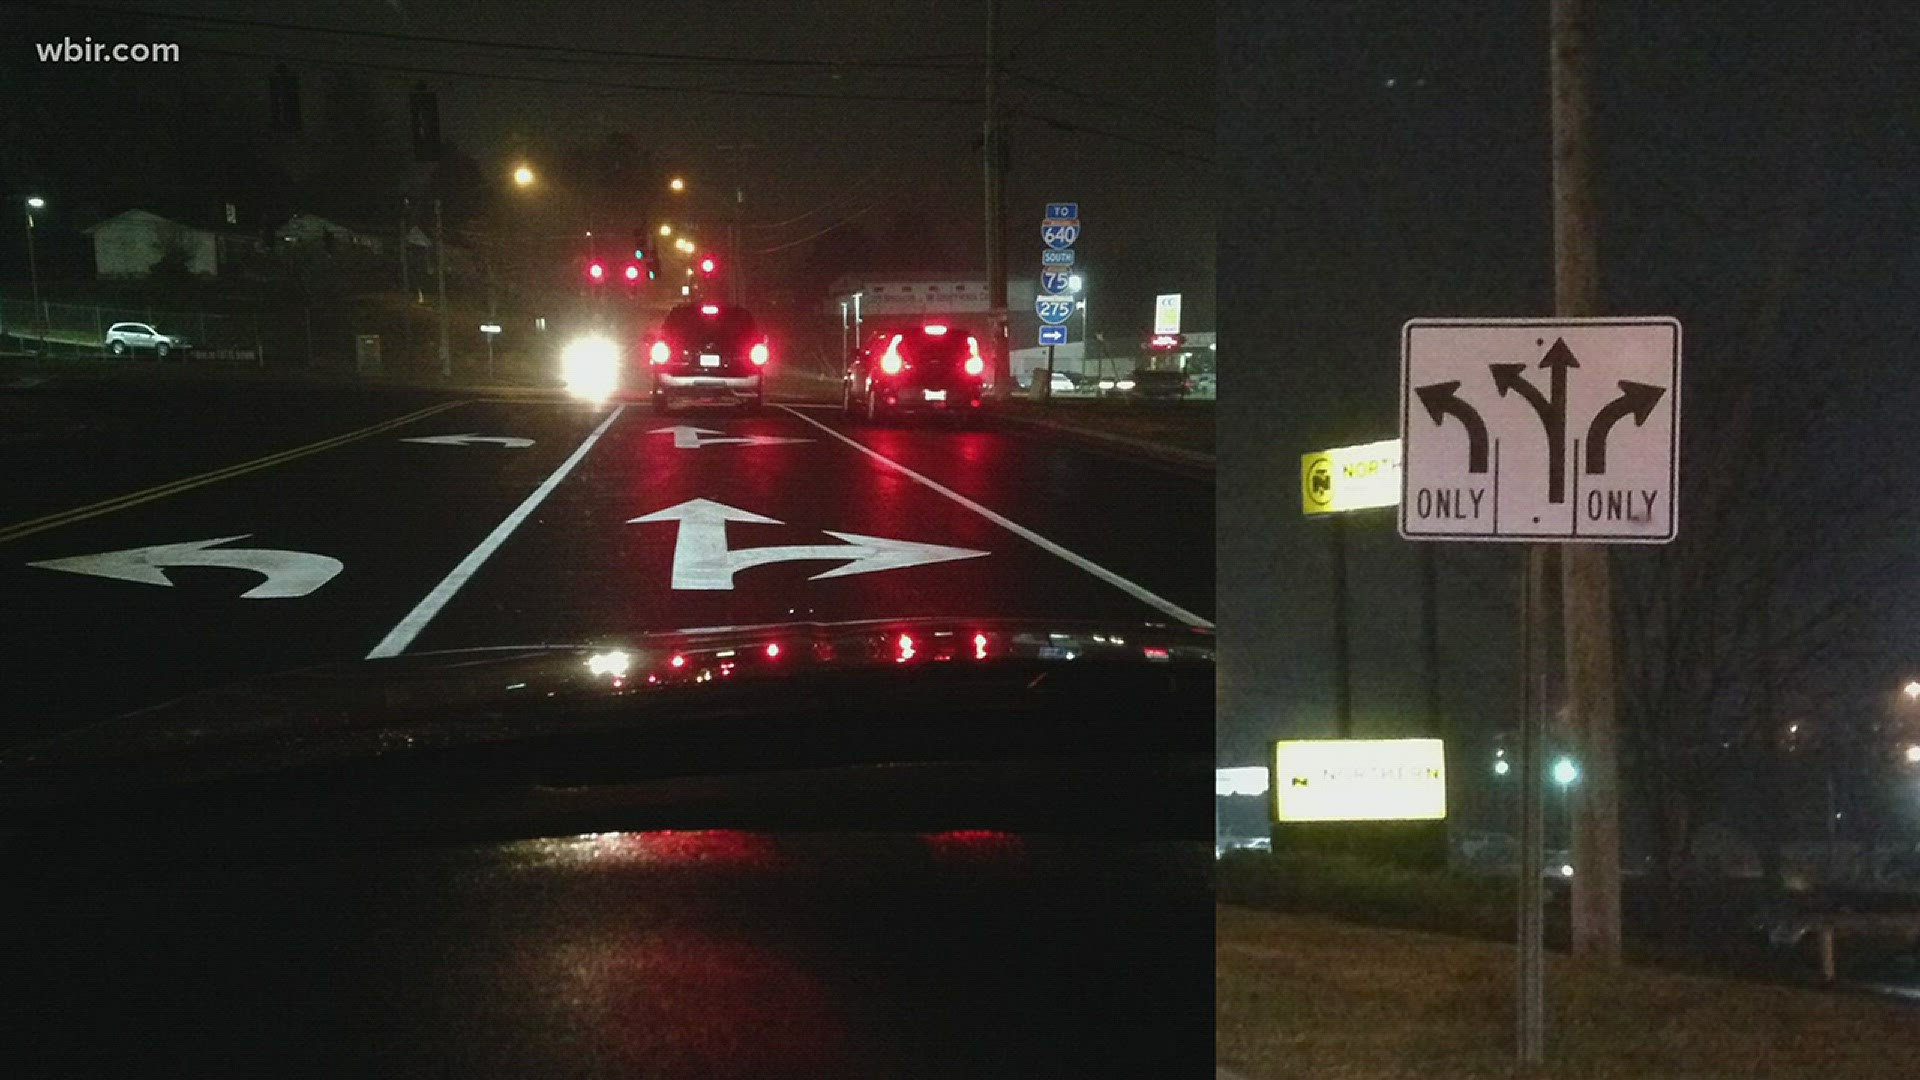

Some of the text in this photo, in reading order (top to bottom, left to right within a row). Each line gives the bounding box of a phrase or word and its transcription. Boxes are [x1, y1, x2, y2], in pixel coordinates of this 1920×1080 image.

[1054, 206, 1069, 217] TO
[1045, 227, 1076, 243] 640
[1044, 252, 1072, 262] SOUTH
[1047, 274, 1067, 289] 75
[1041, 301, 1069, 316] 275
[1417, 488, 1485, 519] ONLY
[1587, 489, 1658, 522] ONLY
